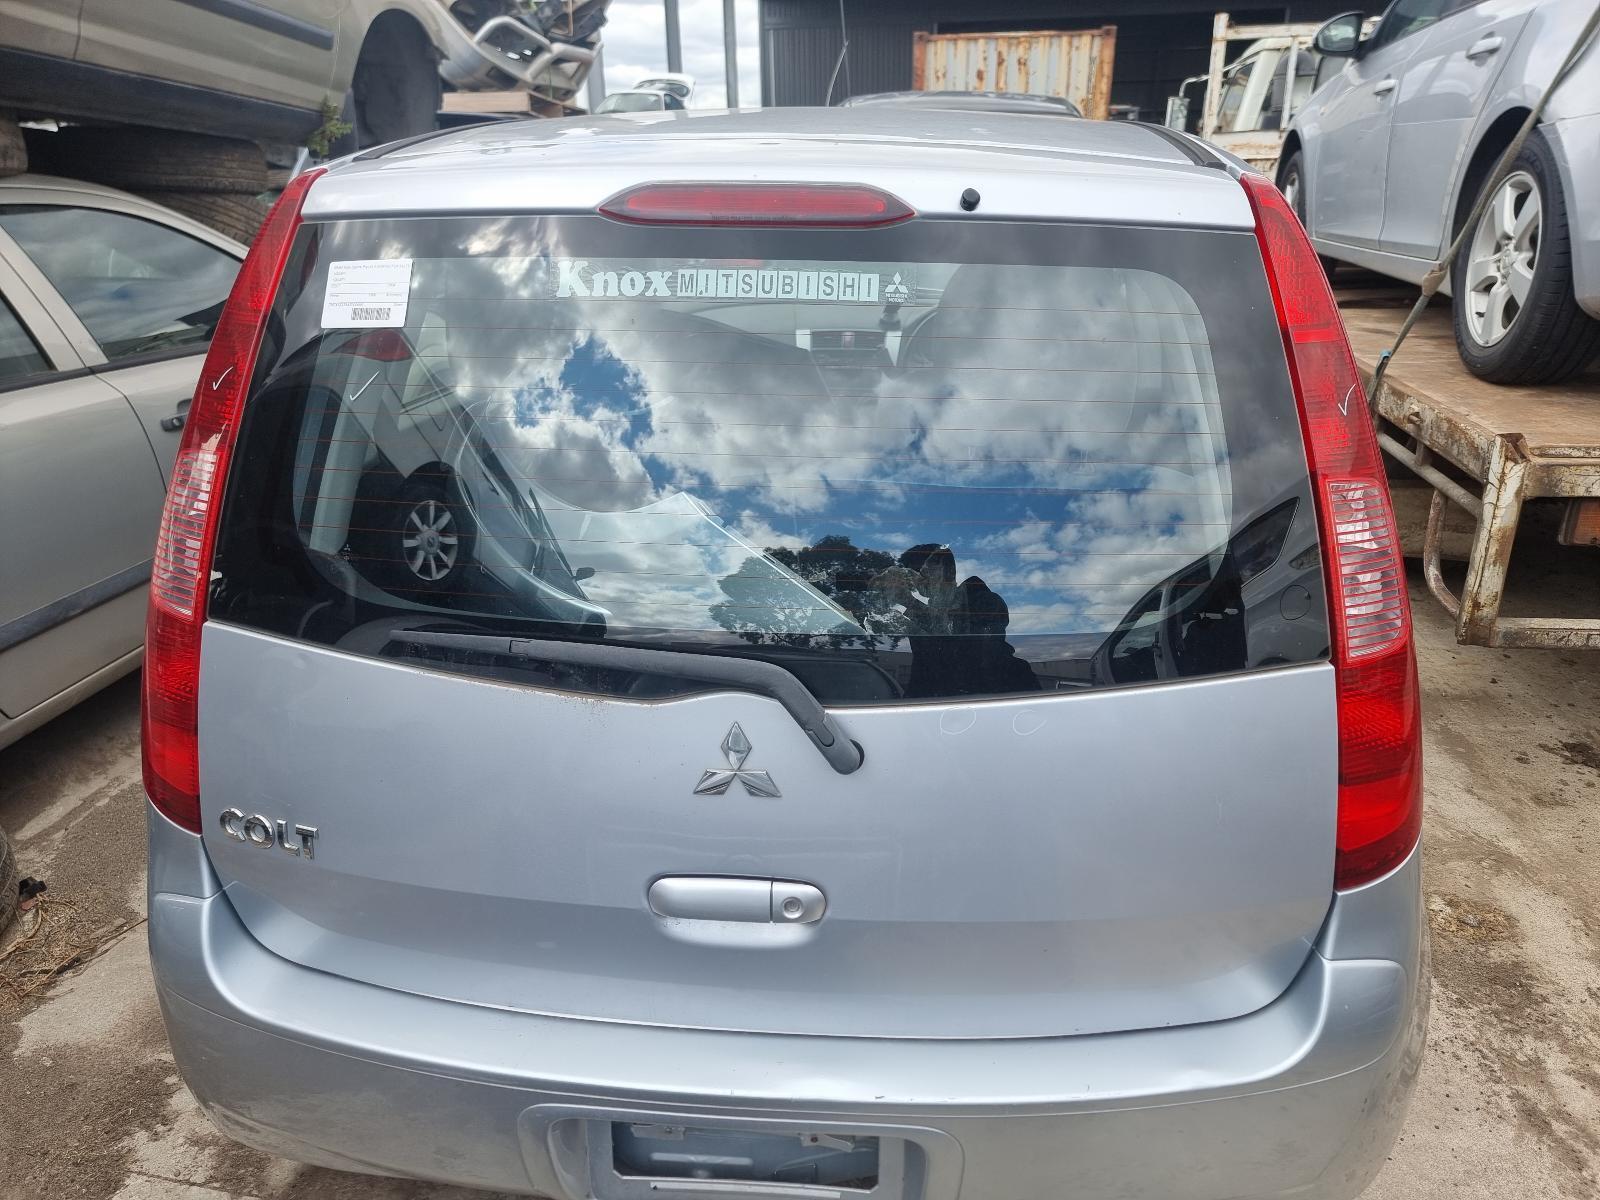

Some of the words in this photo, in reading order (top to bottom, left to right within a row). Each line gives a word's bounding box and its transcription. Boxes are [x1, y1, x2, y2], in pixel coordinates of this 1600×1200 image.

[556, 261, 672, 297] Knox
[679, 272, 877, 299] MITSUBISHI
[220, 807, 319, 861] COLT
